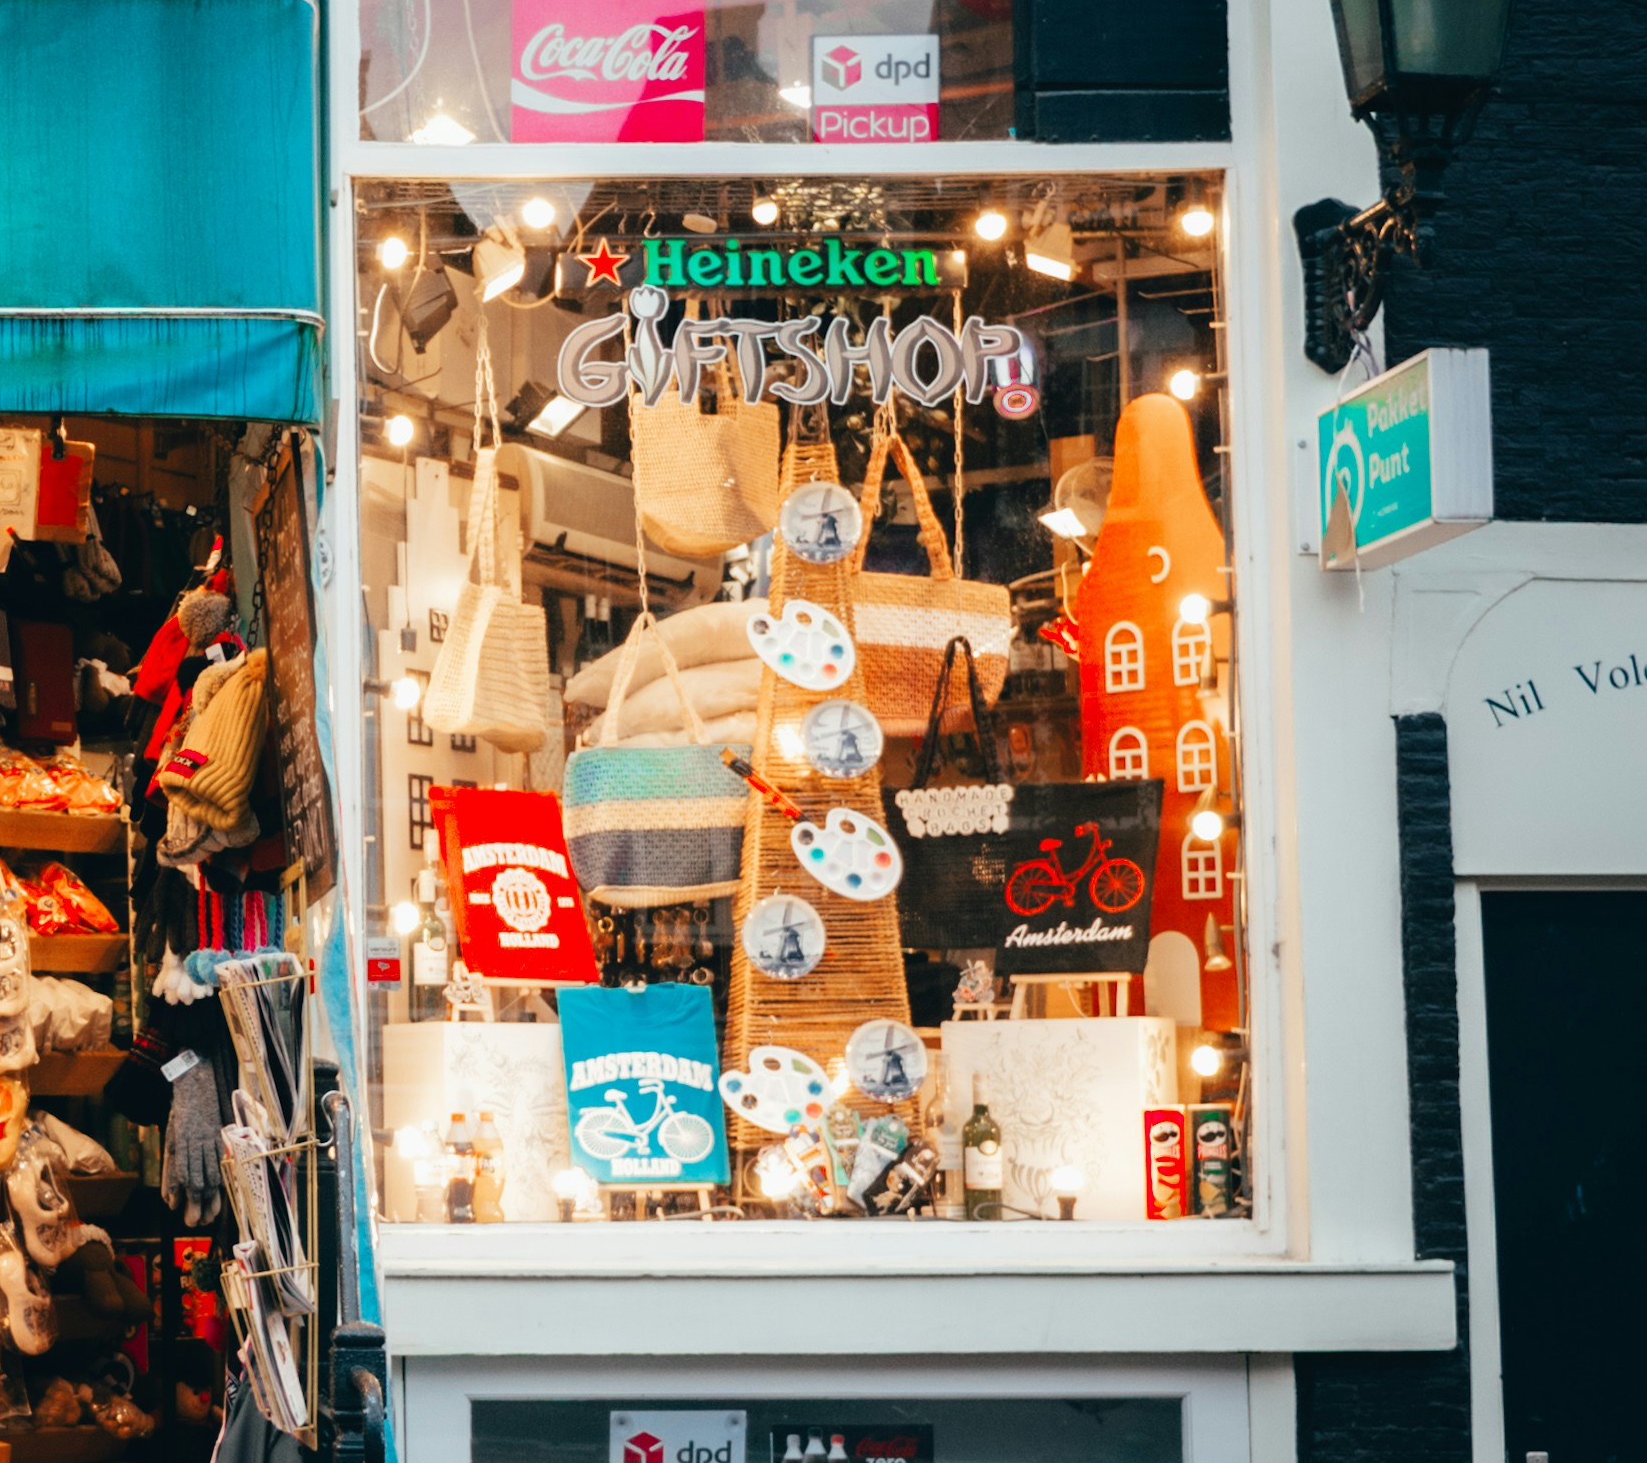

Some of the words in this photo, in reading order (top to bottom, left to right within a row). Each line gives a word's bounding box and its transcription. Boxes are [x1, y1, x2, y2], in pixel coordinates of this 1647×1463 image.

[519, 22, 701, 83] Coca-Cola
[874, 52, 932, 87] dpd
[819, 110, 931, 143] Pickup
[641, 238, 940, 287] Heineken
[1366, 380, 1428, 439] Pakket
[1368, 441, 1411, 490] Punt
[1481, 678, 1547, 728] Nil
[1572, 653, 1647, 695] Vol
[899, 788, 1008, 805] HANDMADE
[907, 804, 1003, 819] CROCHET
[461, 841, 570, 880] AMSTERDAM
[498, 931, 560, 950] HOLLAND
[1004, 916, 1134, 949] Amsterdam
[569, 1050, 715, 1092] AMSTERDAM
[609, 1156, 683, 1177] HOLLAND
